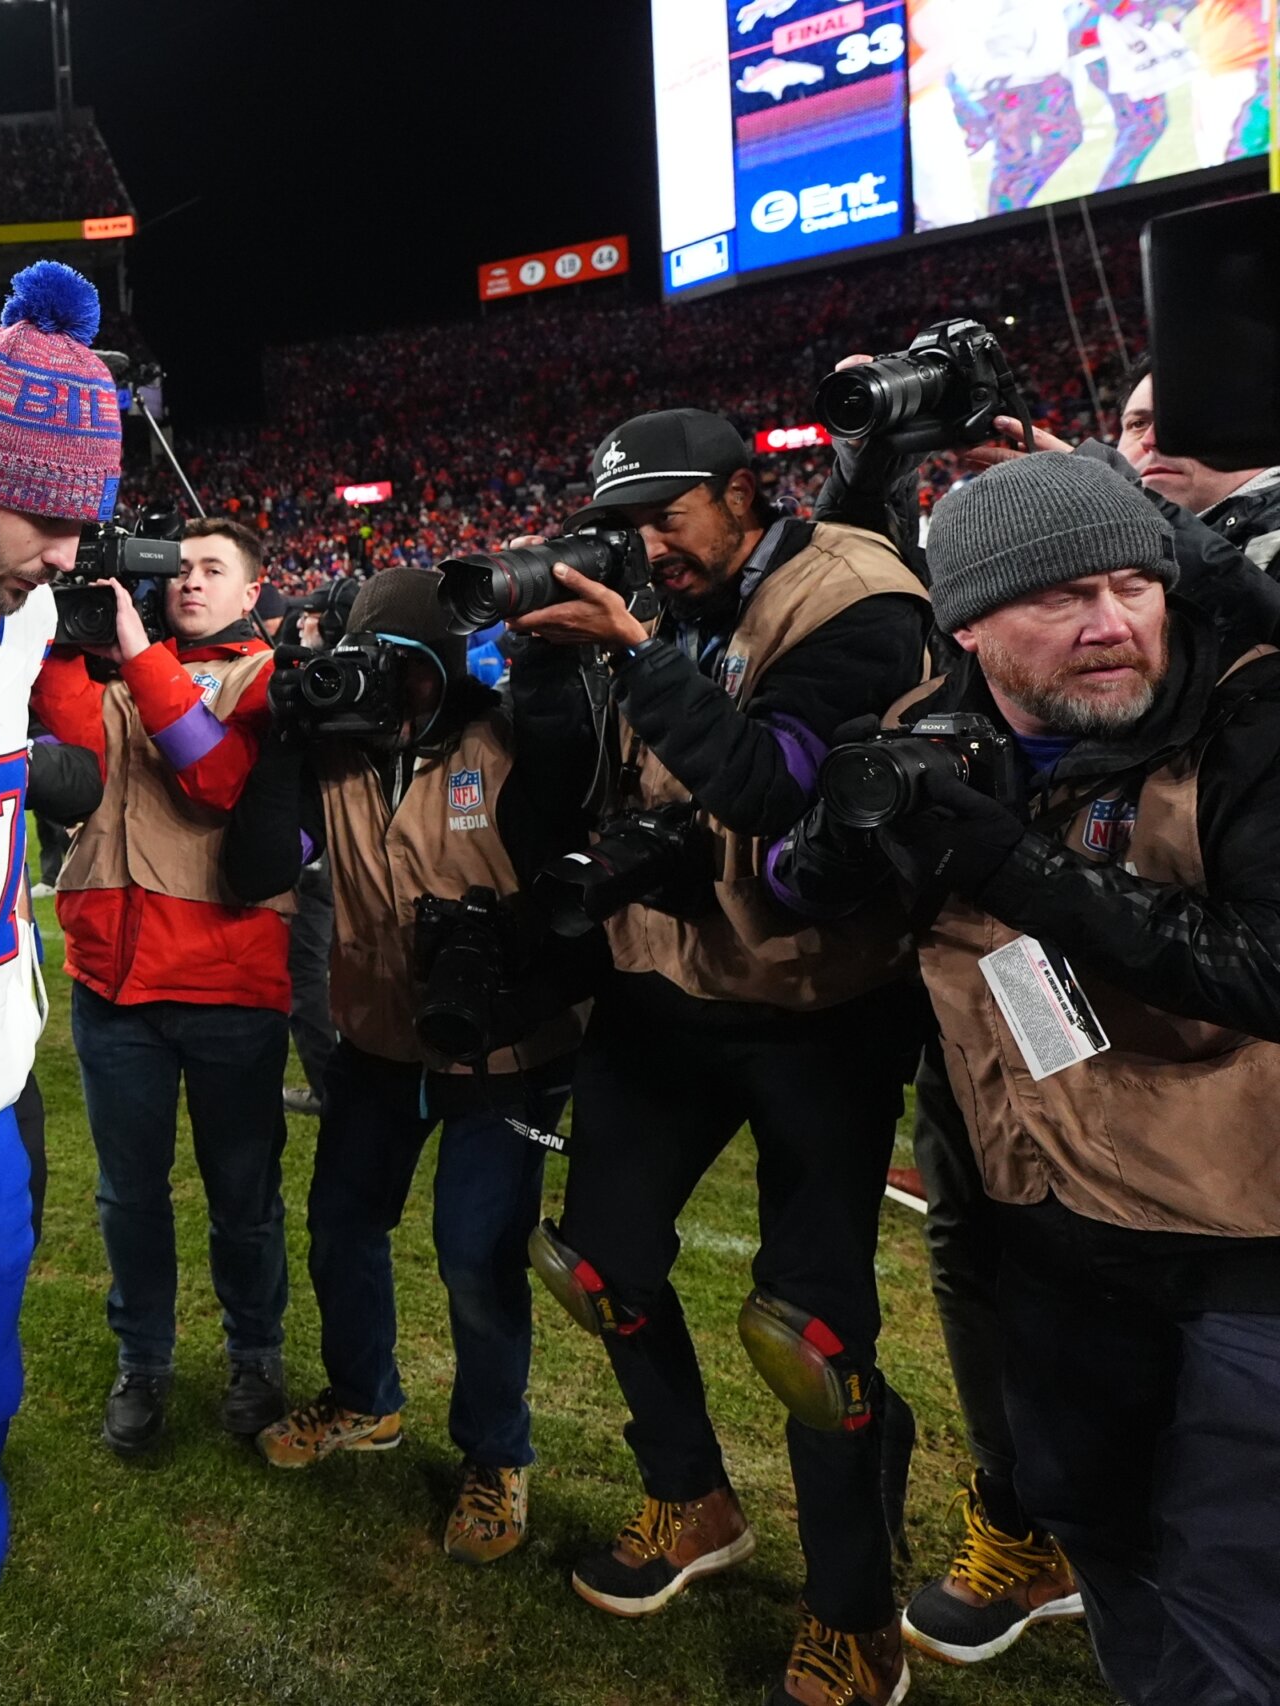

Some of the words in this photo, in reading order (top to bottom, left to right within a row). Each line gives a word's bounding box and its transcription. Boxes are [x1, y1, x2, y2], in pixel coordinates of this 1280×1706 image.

[787, 15, 849, 44] FINAL
[836, 23, 905, 75] 33
[799, 172, 880, 220] Ent
[612, 461, 640, 476] DUNES
[337, 645, 359, 653] Nikon
[453, 785, 478, 806] NFL
[449, 813, 489, 831] MEDIA
[528, 1127, 565, 1151] NPS
